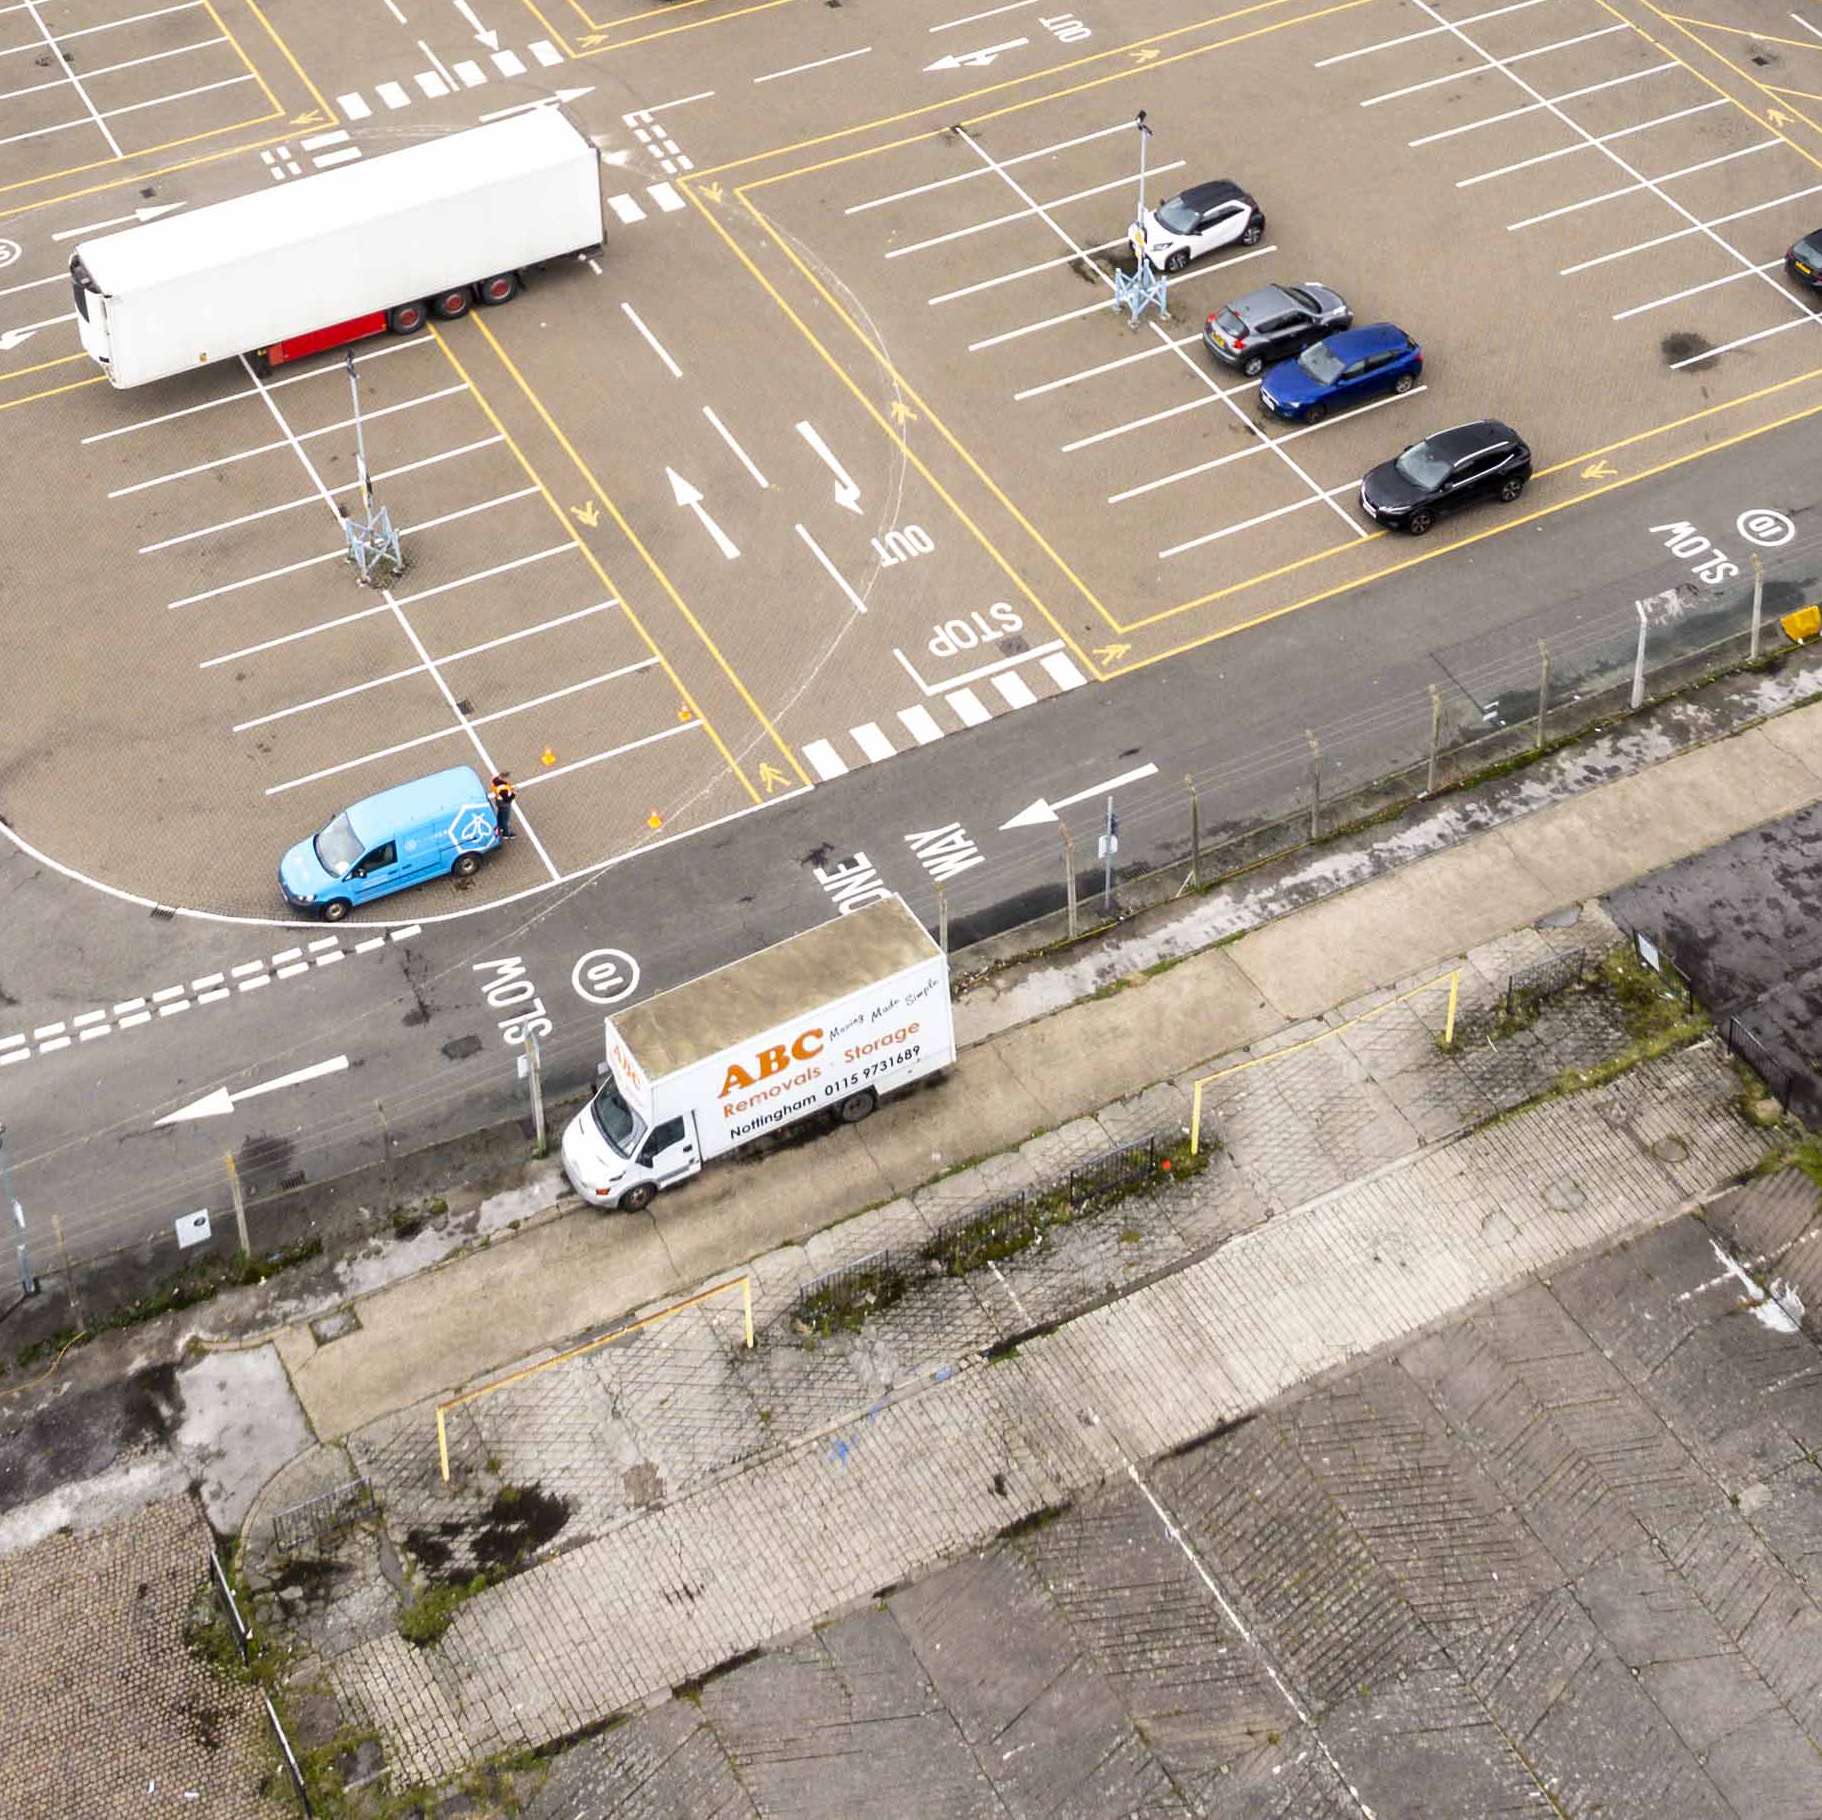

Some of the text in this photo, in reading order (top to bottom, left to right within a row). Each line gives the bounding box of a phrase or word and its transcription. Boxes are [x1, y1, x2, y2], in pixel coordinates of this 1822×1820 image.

[1038, 13, 1092, 43] OUT
[871, 525, 936, 568] OUT
[1649, 520, 1740, 584] SLOW
[928, 602, 1024, 658] STOP
[903, 822, 986, 883] WAY
[473, 956, 554, 1045] SLOW
[828, 977, 940, 1042] Moving Made Simple
[717, 1027, 825, 1099] ABC
[722, 1020, 921, 1119] Removals Storage
[729, 1044, 922, 1141] Nottingham 0115 9731689
